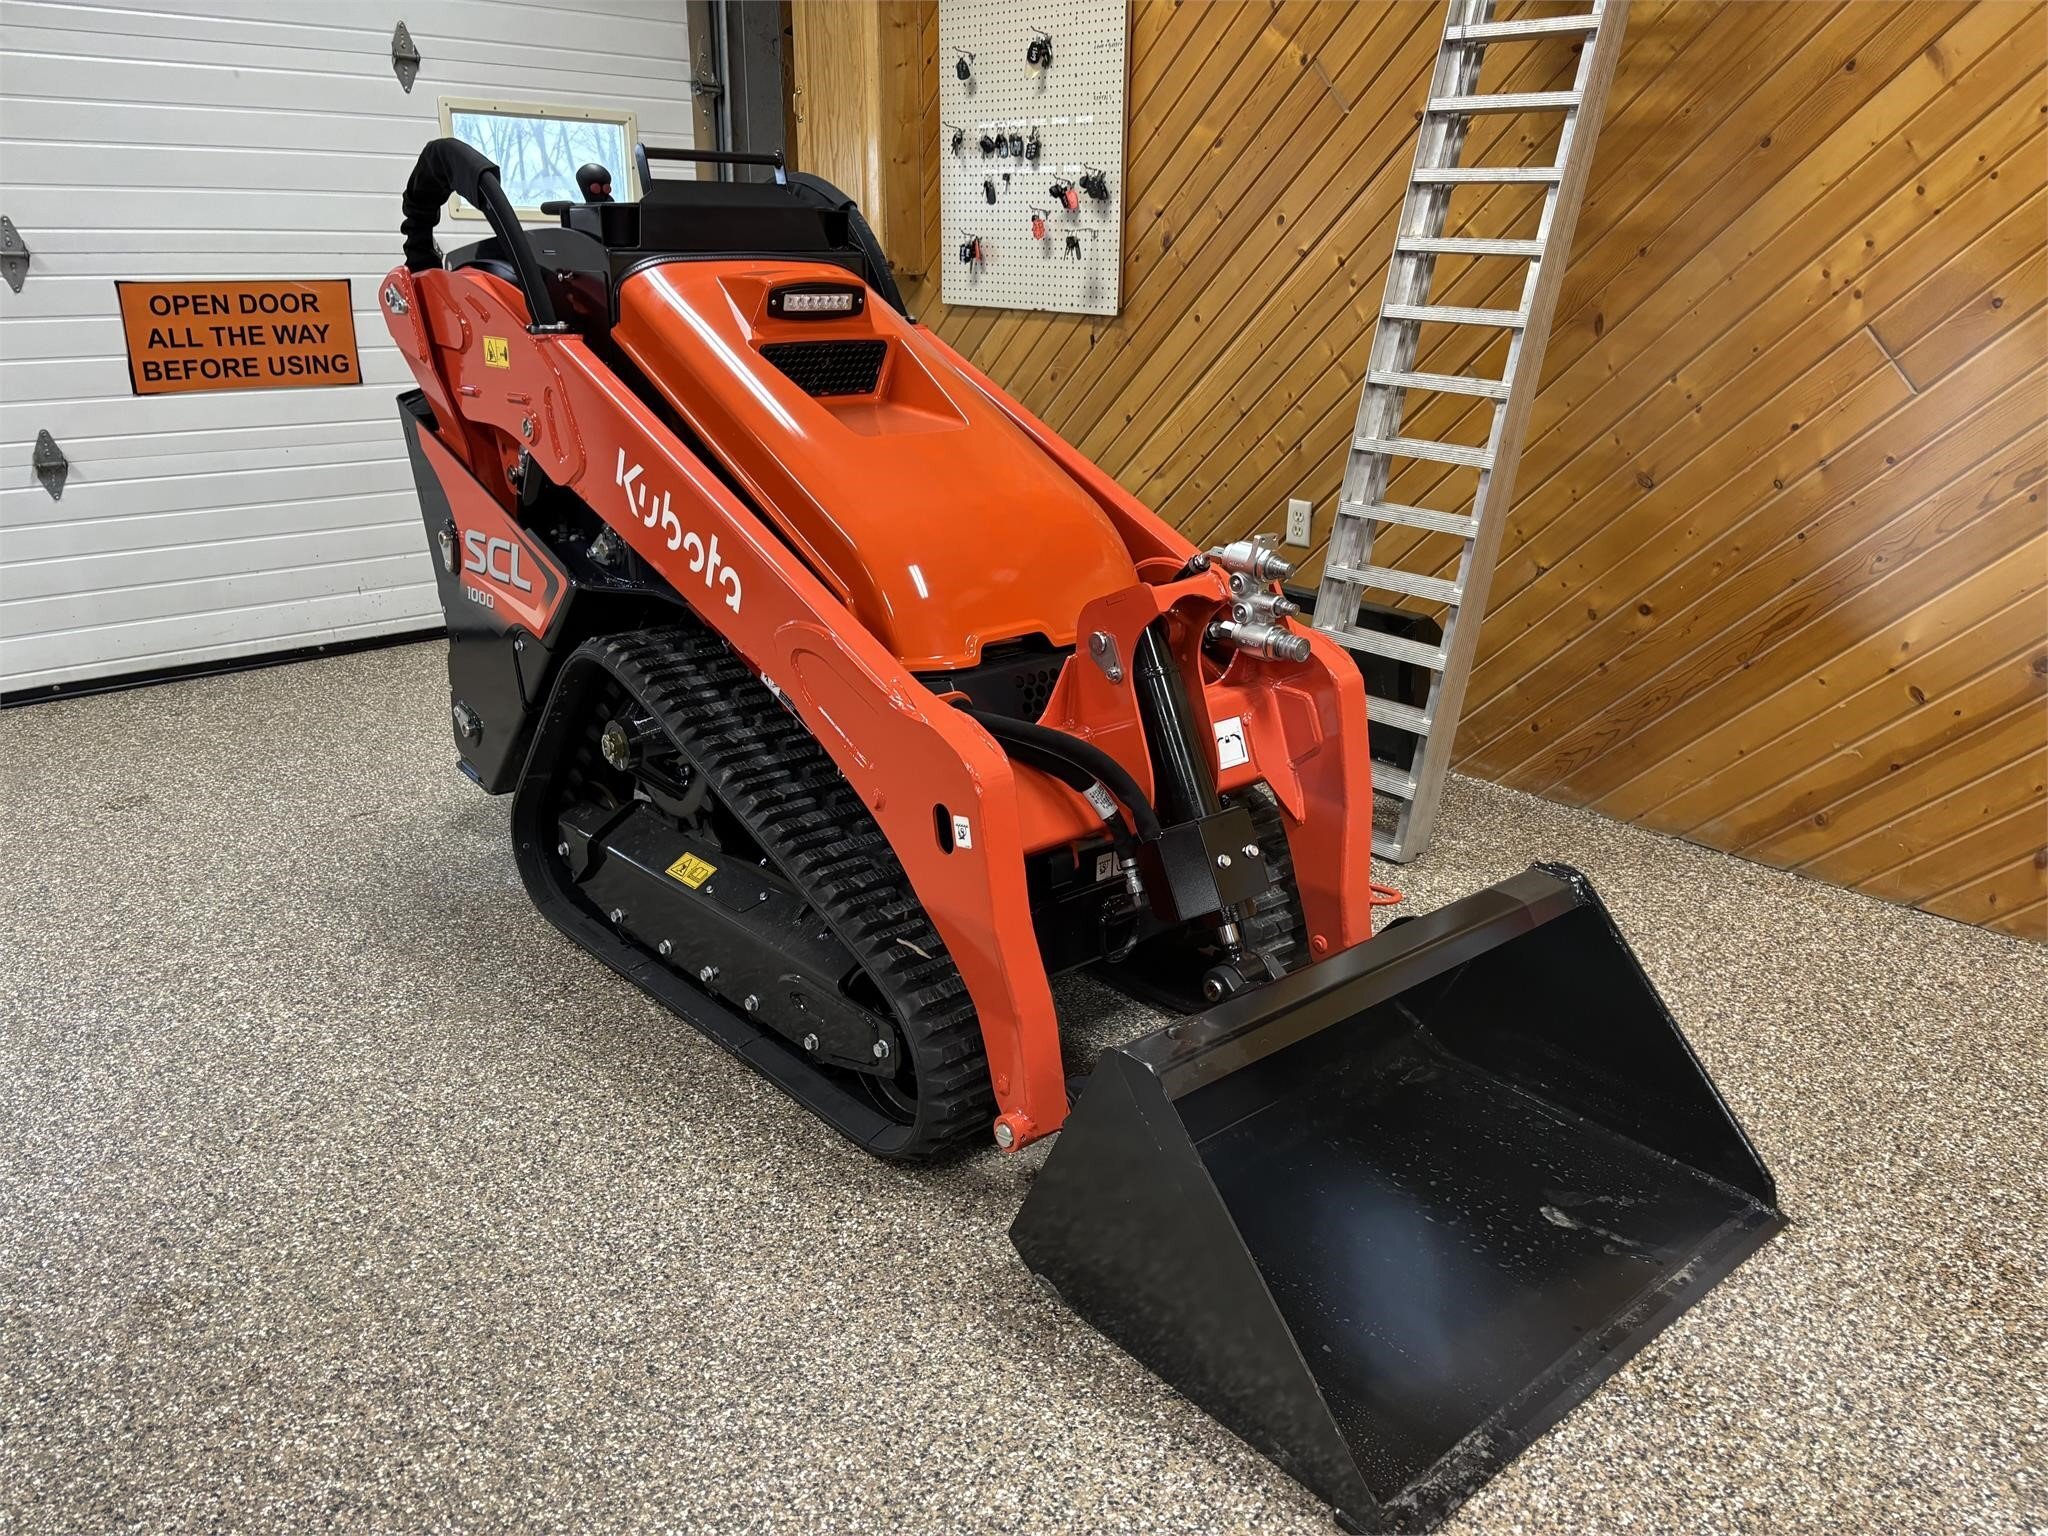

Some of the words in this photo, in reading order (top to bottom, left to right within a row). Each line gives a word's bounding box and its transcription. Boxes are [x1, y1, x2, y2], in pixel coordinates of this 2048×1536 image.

[149, 294, 230, 315] OPEN
[239, 293, 320, 314] DOOR
[148, 328, 203, 349] ALL
[209, 325, 266, 347] THE
[272, 324, 330, 345] WAY
[142, 358, 260, 382] BEFORE
[268, 354, 350, 376] USING
[616, 447, 742, 614] Kubota
[464, 529, 532, 591] SCL
[466, 586, 494, 609] 1000
